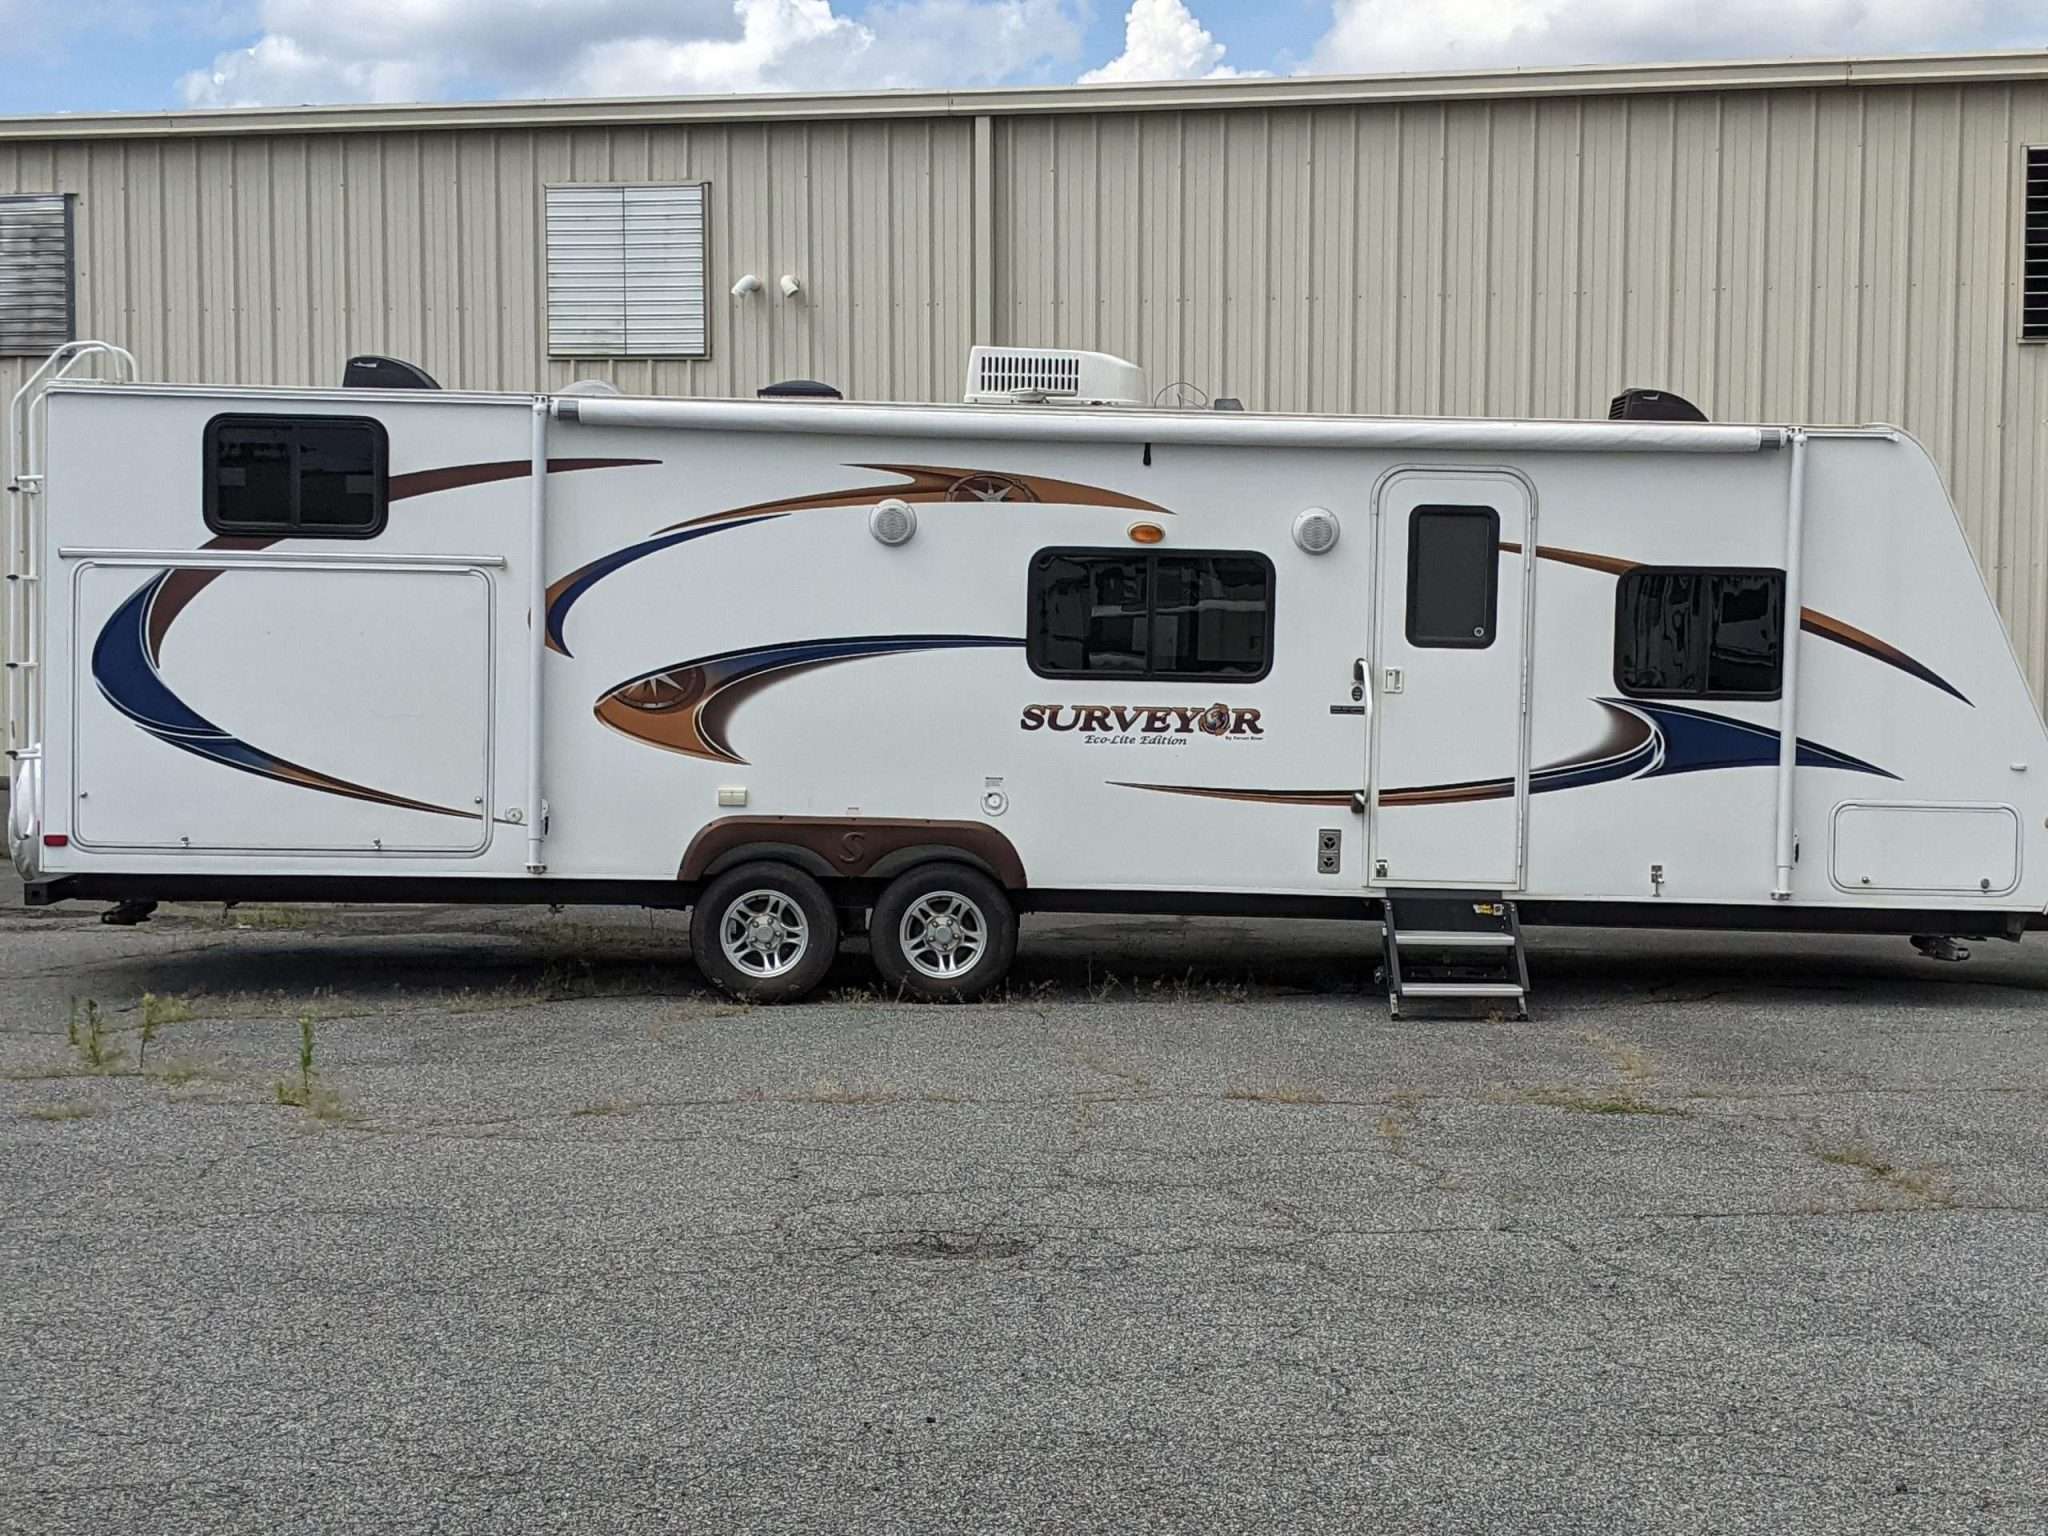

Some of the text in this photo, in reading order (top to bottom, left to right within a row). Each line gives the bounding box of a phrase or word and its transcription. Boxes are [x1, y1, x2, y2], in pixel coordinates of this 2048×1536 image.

[1020, 703, 1264, 736] SURVEYOR
[1084, 735, 1187, 746] Eco-Lite Edition
